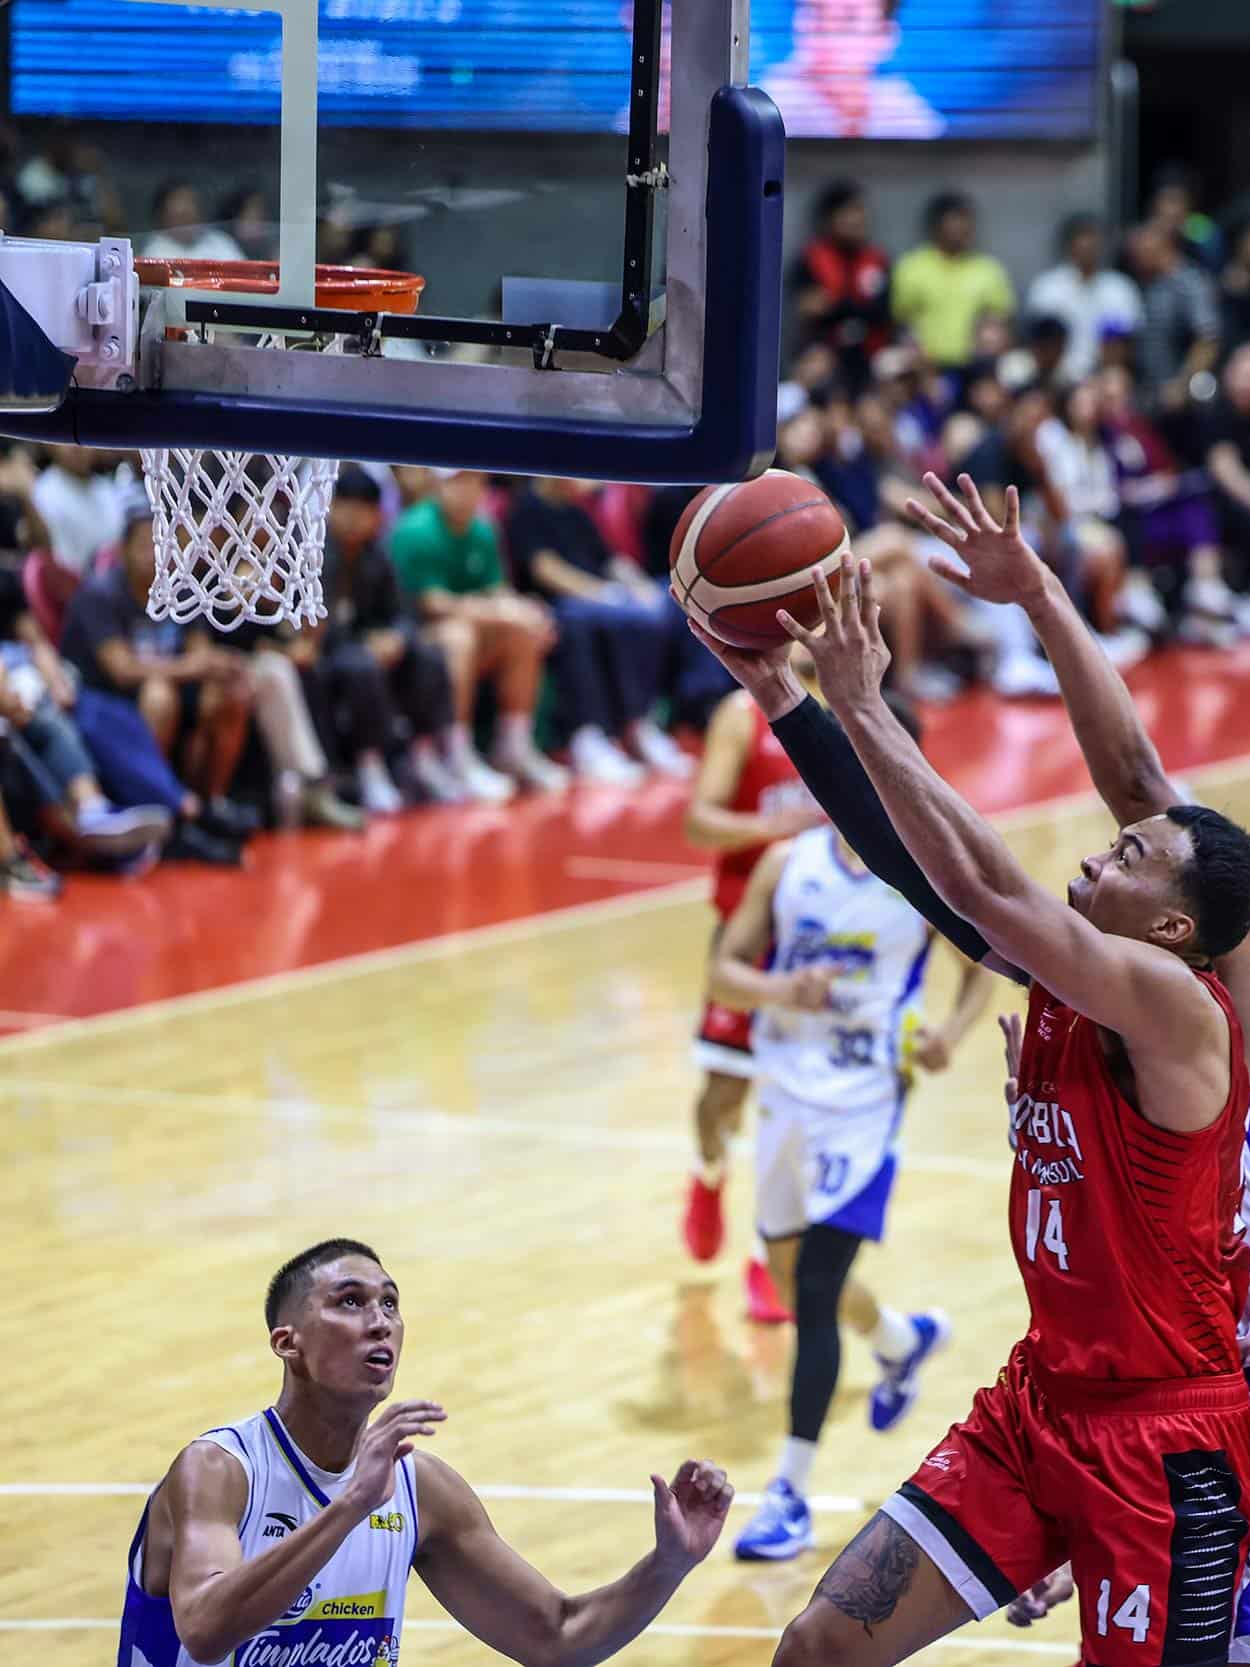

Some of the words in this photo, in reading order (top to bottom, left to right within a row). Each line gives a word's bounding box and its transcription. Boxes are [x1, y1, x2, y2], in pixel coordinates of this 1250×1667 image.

[1026, 1188, 1069, 1271] 14
[262, 1524, 285, 1538] ANTA
[321, 1602, 375, 1616] Chicken
[1096, 1578, 1151, 1643] 14
[239, 1628, 376, 1667] Timplados
